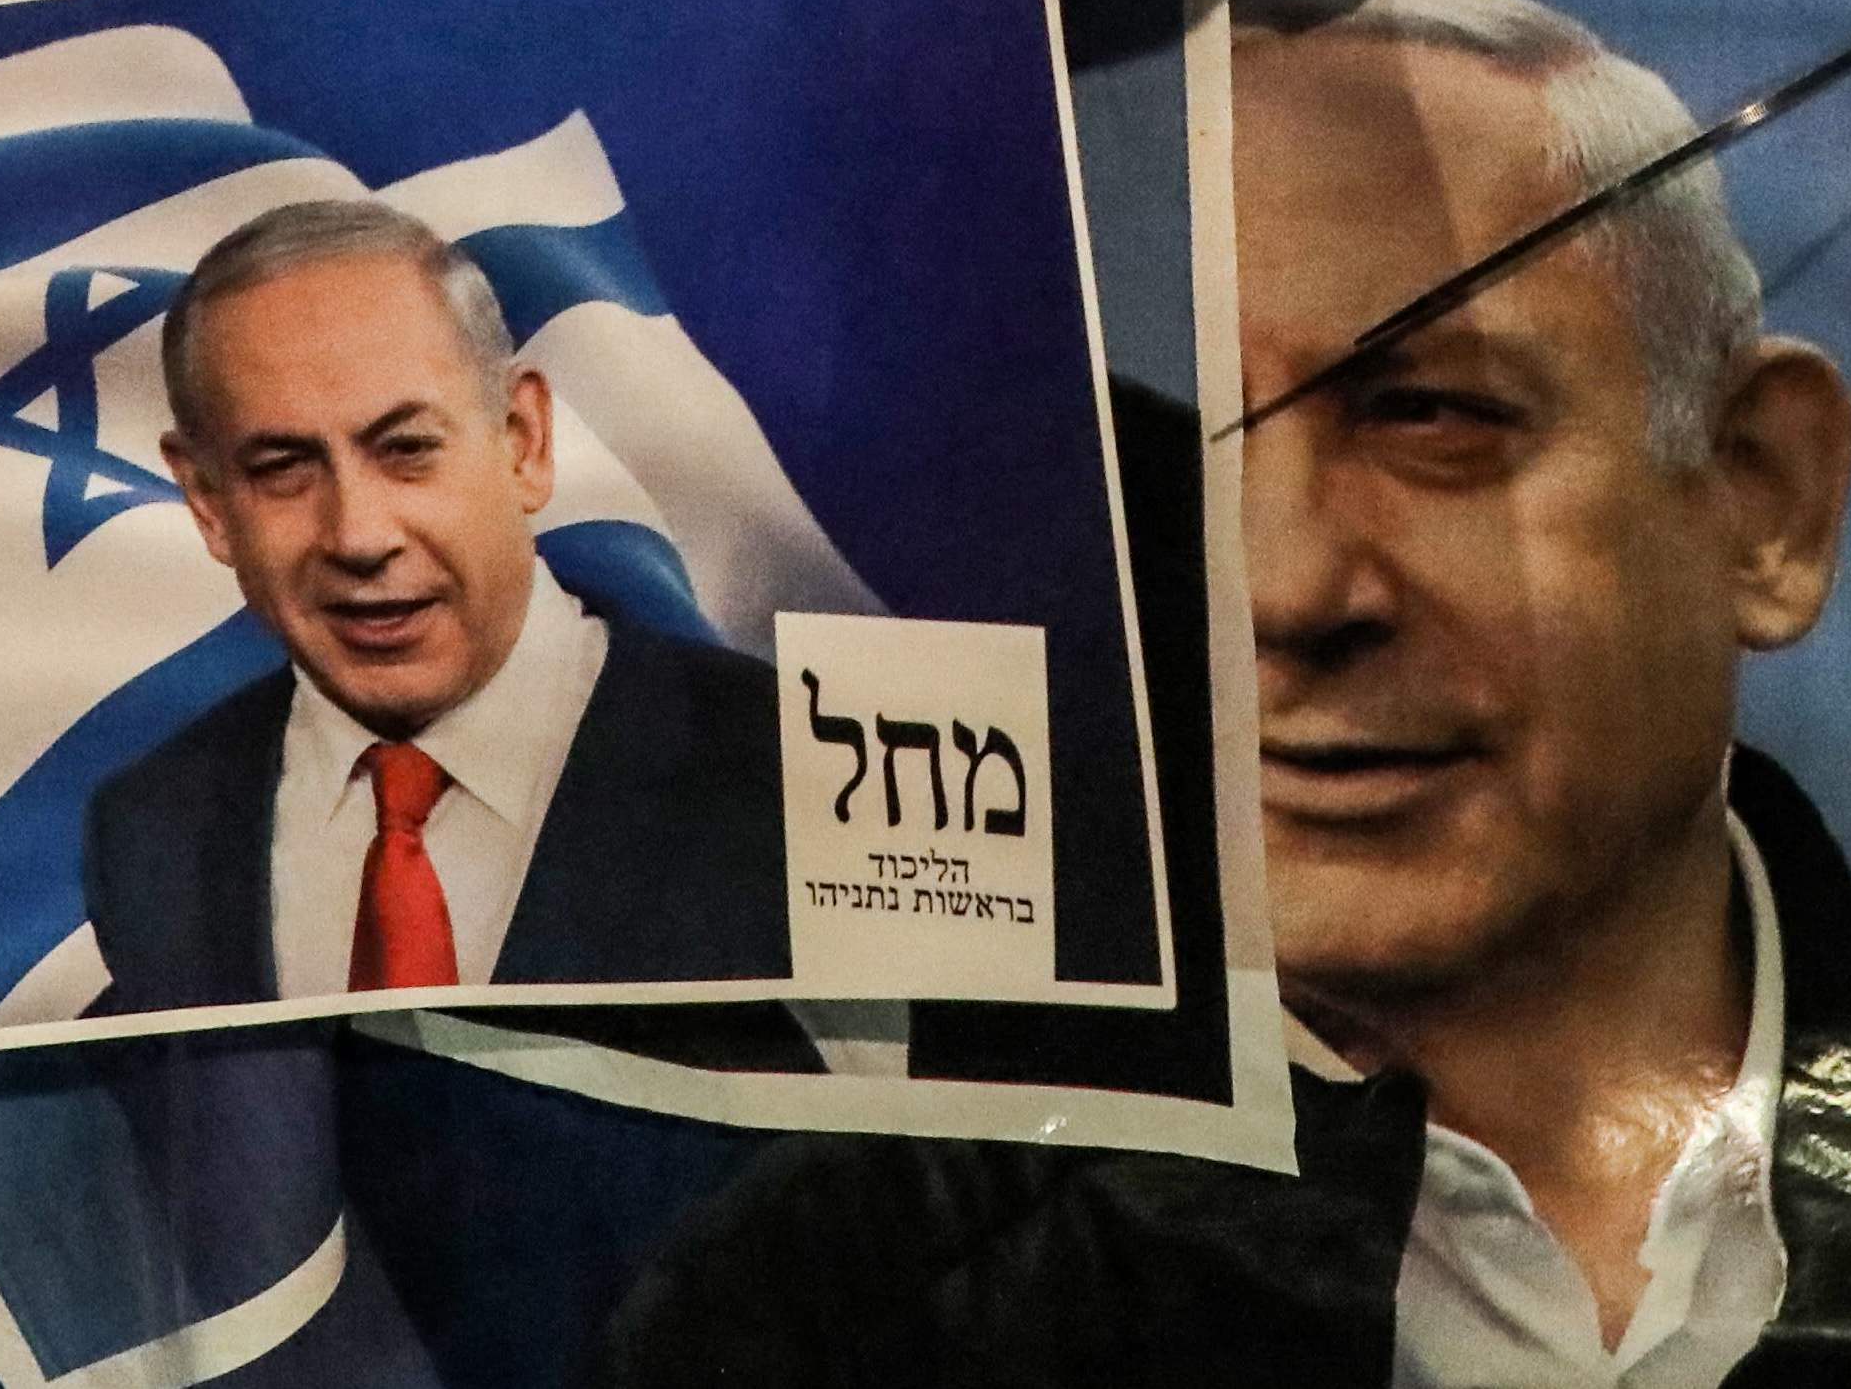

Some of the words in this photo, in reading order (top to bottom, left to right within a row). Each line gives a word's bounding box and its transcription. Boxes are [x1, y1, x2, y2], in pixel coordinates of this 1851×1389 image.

[801, 667, 1026, 838] מחל
[868, 847, 970, 885] הליכוד
[804, 880, 900, 910] נתניהו
[912, 887, 1036, 924] בראשות
